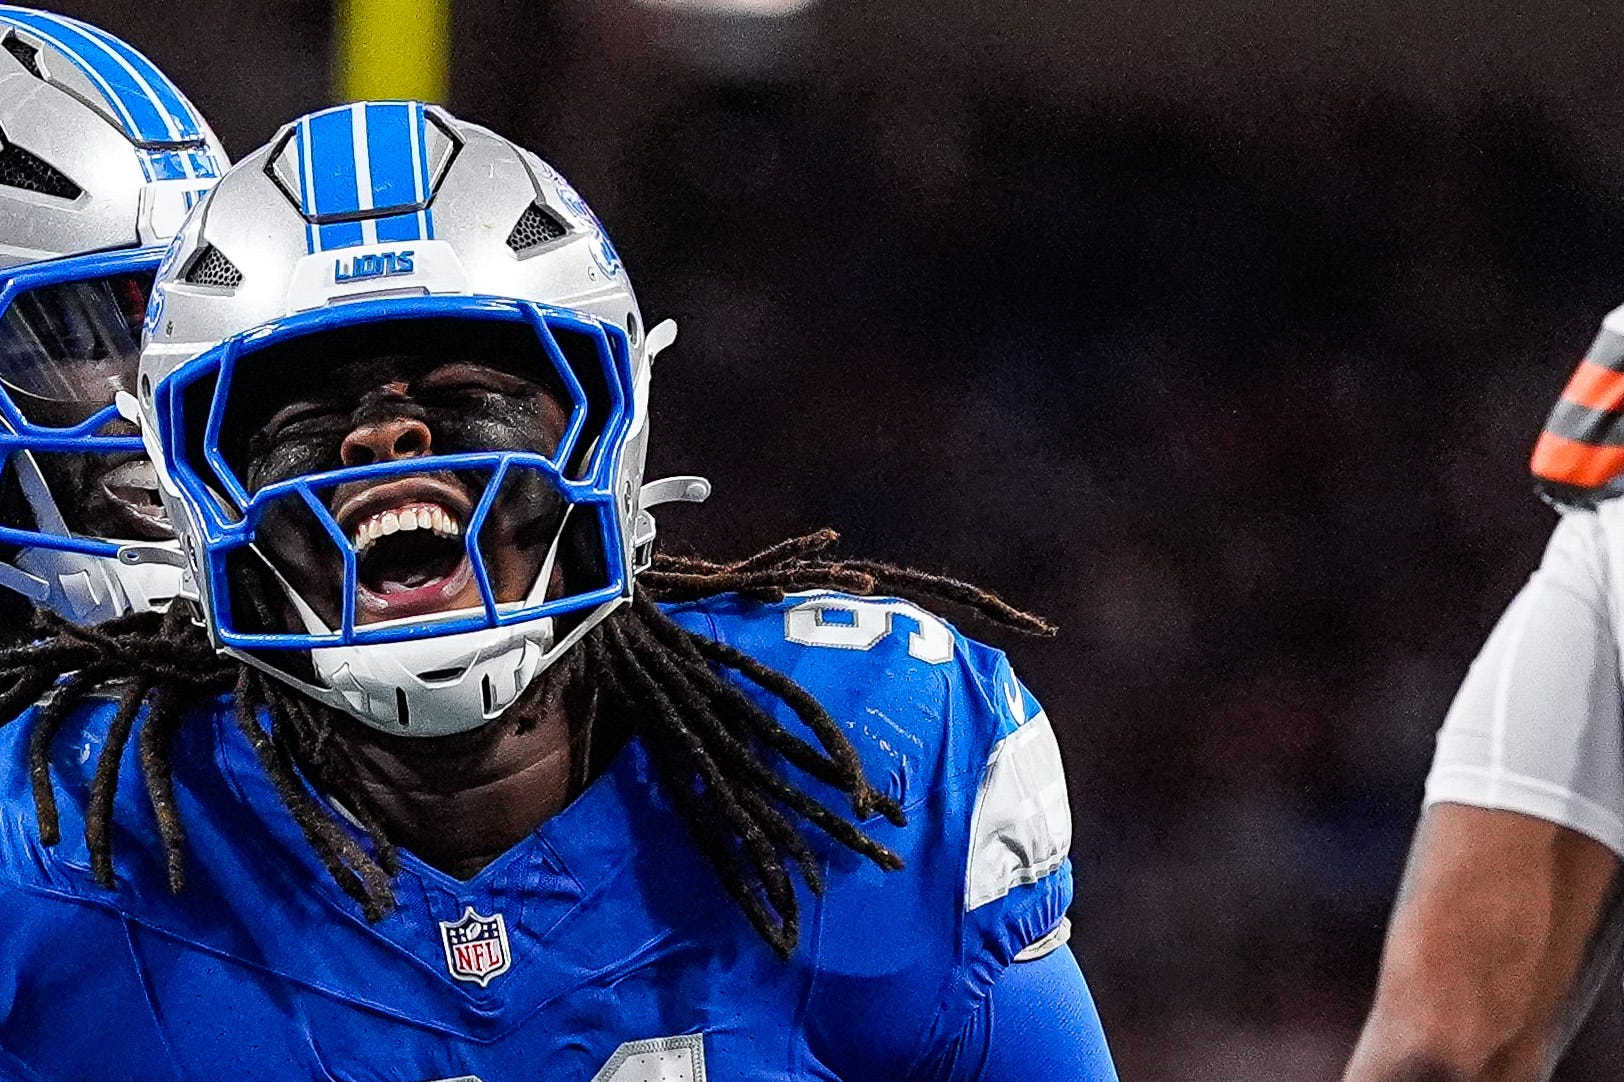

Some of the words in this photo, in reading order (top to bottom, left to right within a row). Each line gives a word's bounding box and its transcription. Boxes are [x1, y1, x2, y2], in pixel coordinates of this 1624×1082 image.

[335, 251, 415, 284] LIONS
[784, 589, 955, 664] 9
[454, 941, 500, 972] NFL
